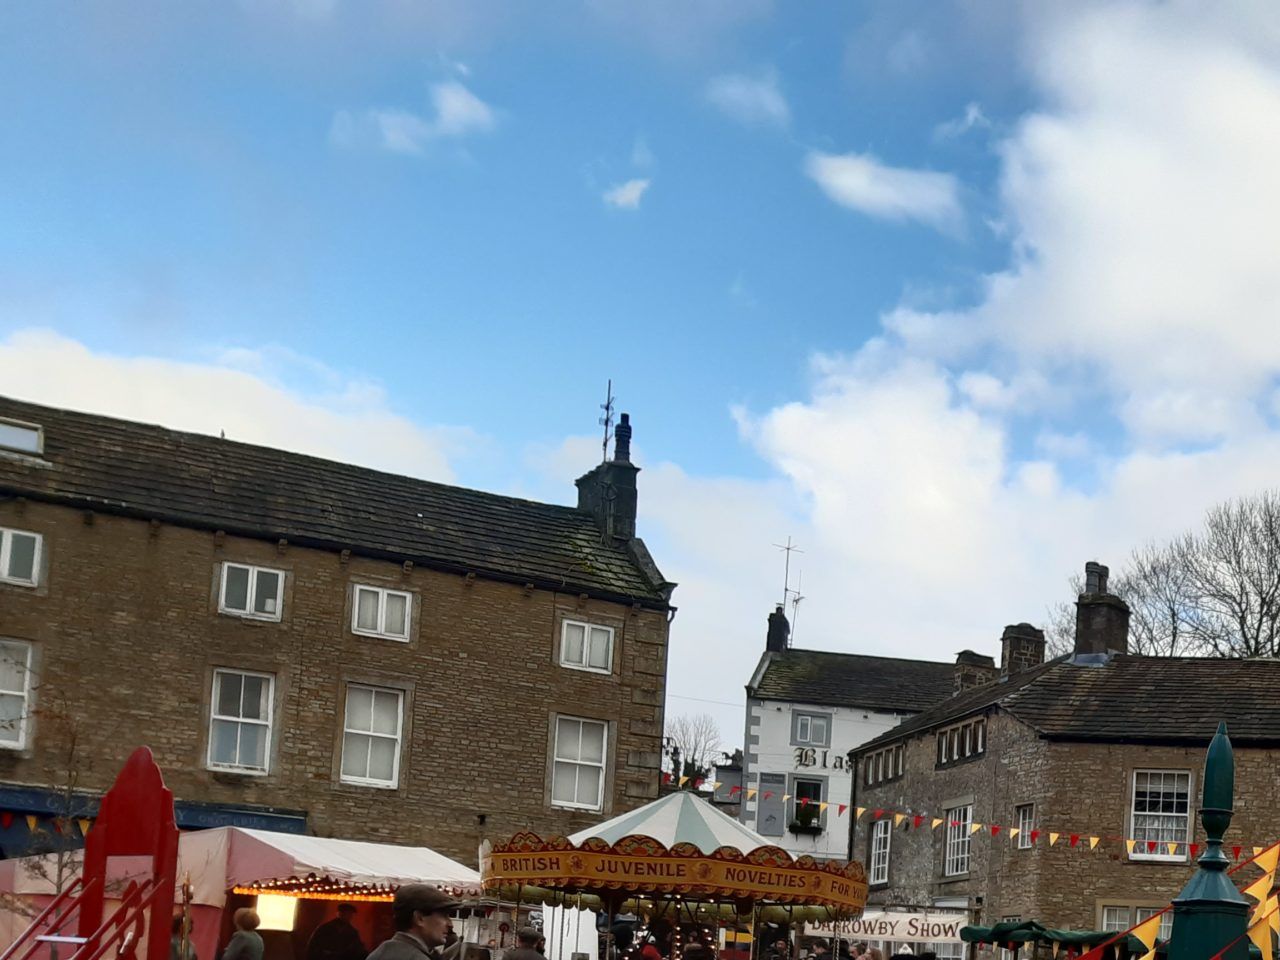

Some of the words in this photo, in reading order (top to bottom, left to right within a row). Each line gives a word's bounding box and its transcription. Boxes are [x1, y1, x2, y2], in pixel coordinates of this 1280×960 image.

[502, 857, 561, 872] BRITISH
[595, 859, 687, 878] JUVENILE
[725, 867, 806, 888] NOVELTIES
[830, 880, 850, 897] FOR
